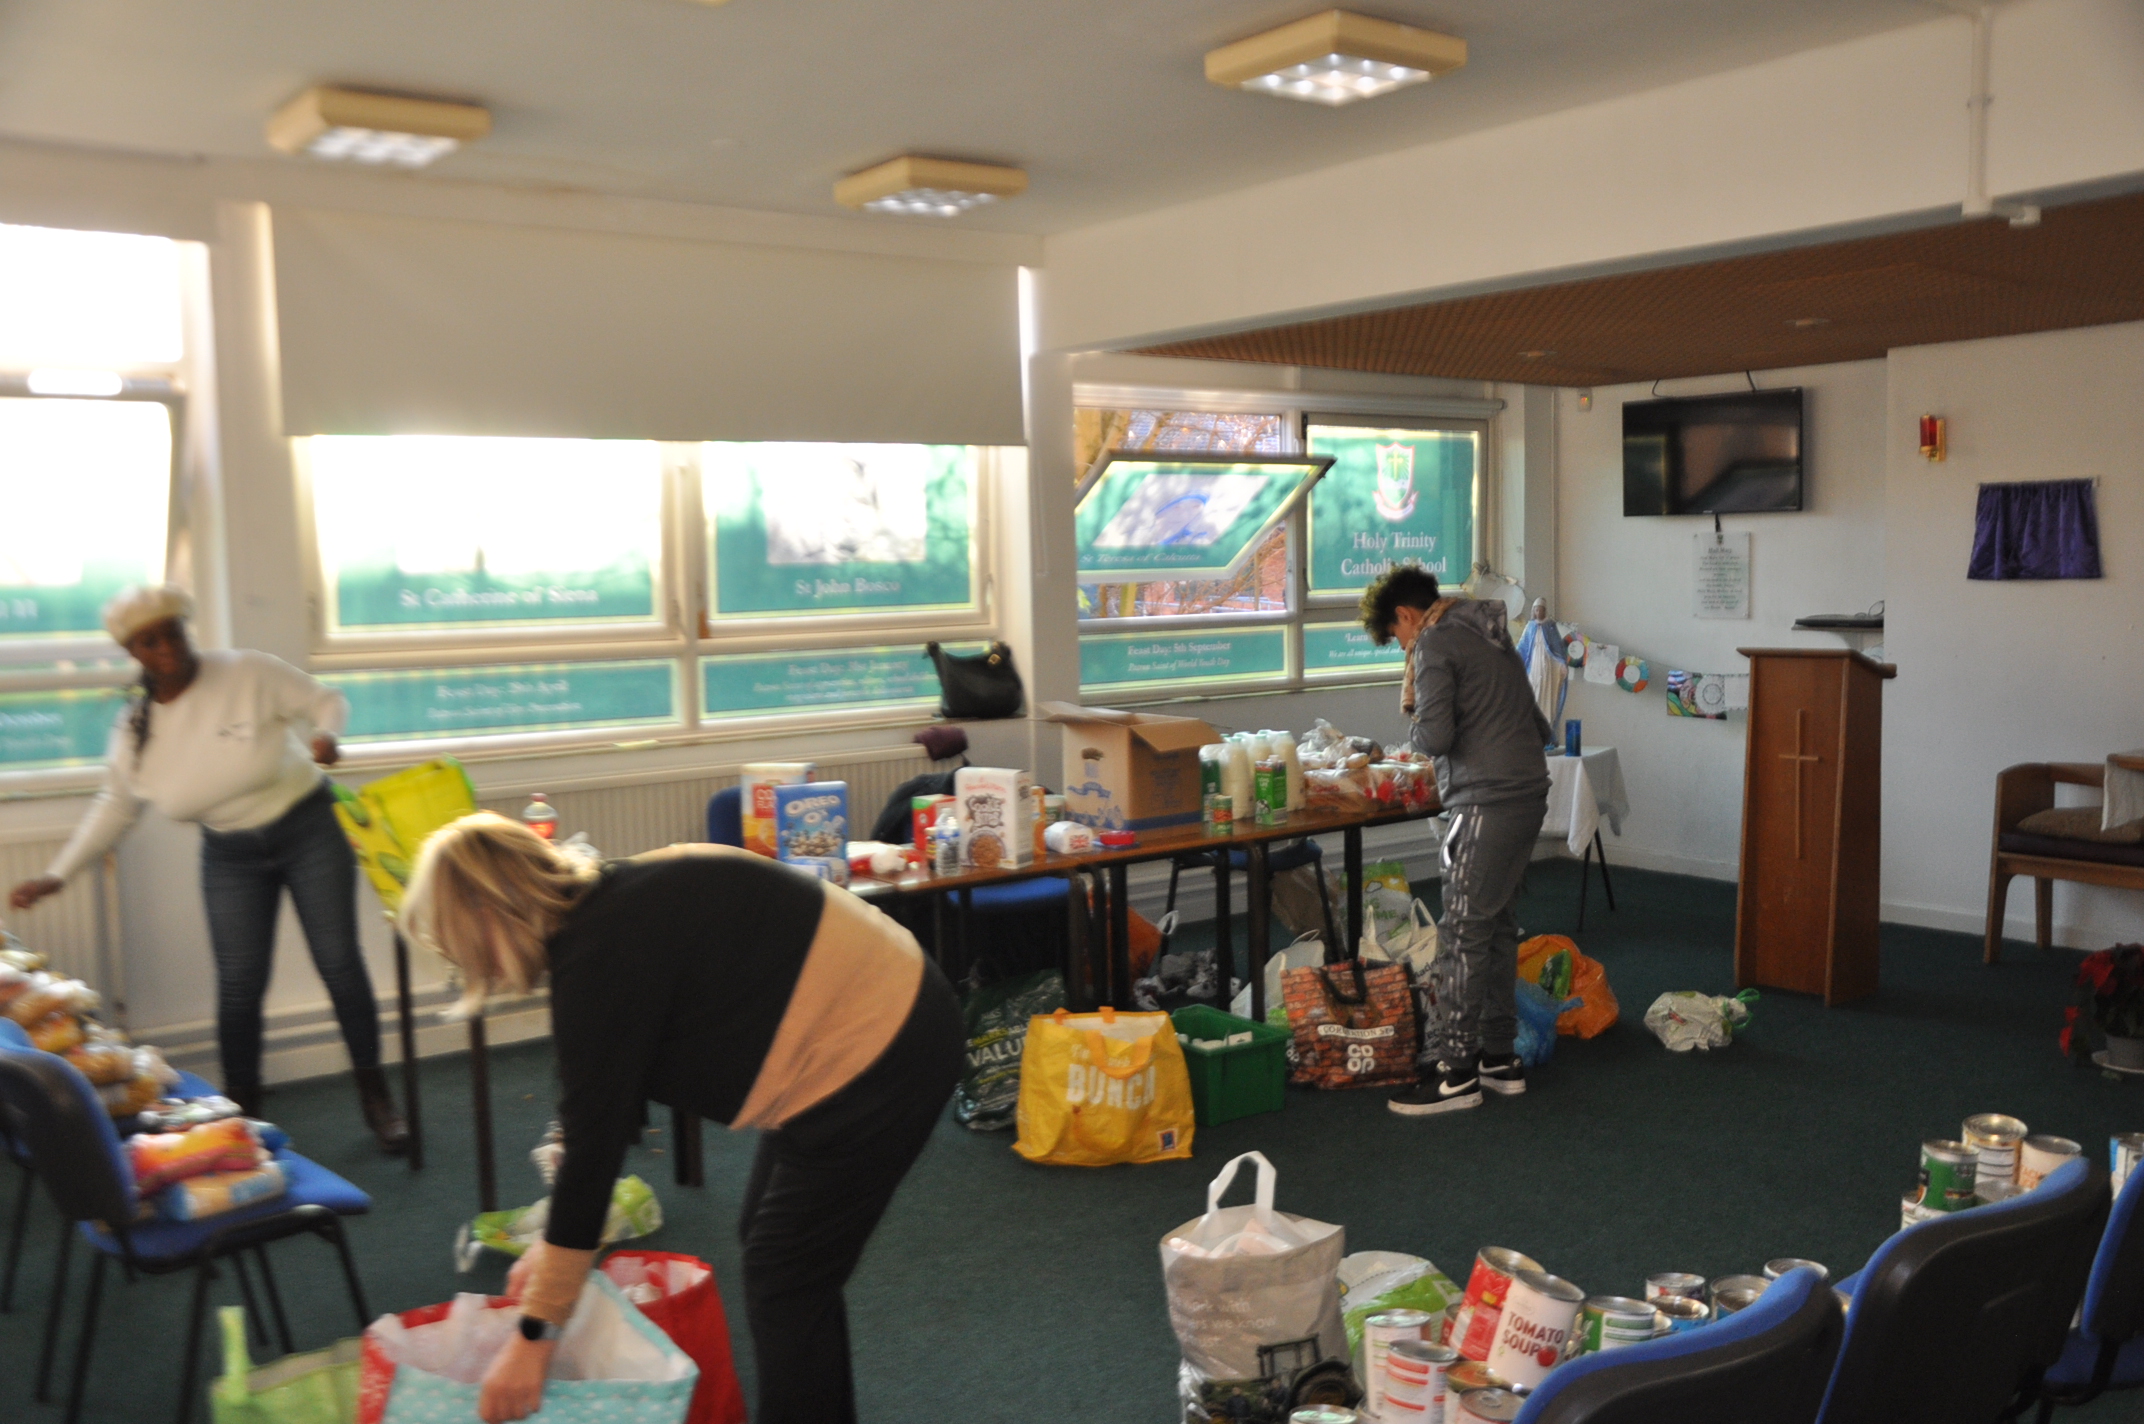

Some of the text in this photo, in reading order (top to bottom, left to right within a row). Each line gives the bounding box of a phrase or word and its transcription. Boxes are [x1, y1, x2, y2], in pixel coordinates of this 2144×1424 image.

[1353, 531, 1436, 553] Holy Trinity
[1153, 552, 1200, 562] Calcutta
[1402, 556, 1446, 573] Shool
[814, 578, 851, 598] John
[1189, 641, 1231, 655] September
[784, 795, 841, 817] OREO
[966, 1037, 1024, 1067] VALU
[1508, 1311, 1565, 1344] TOMATO
[1503, 1328, 1542, 1357] SOUP
